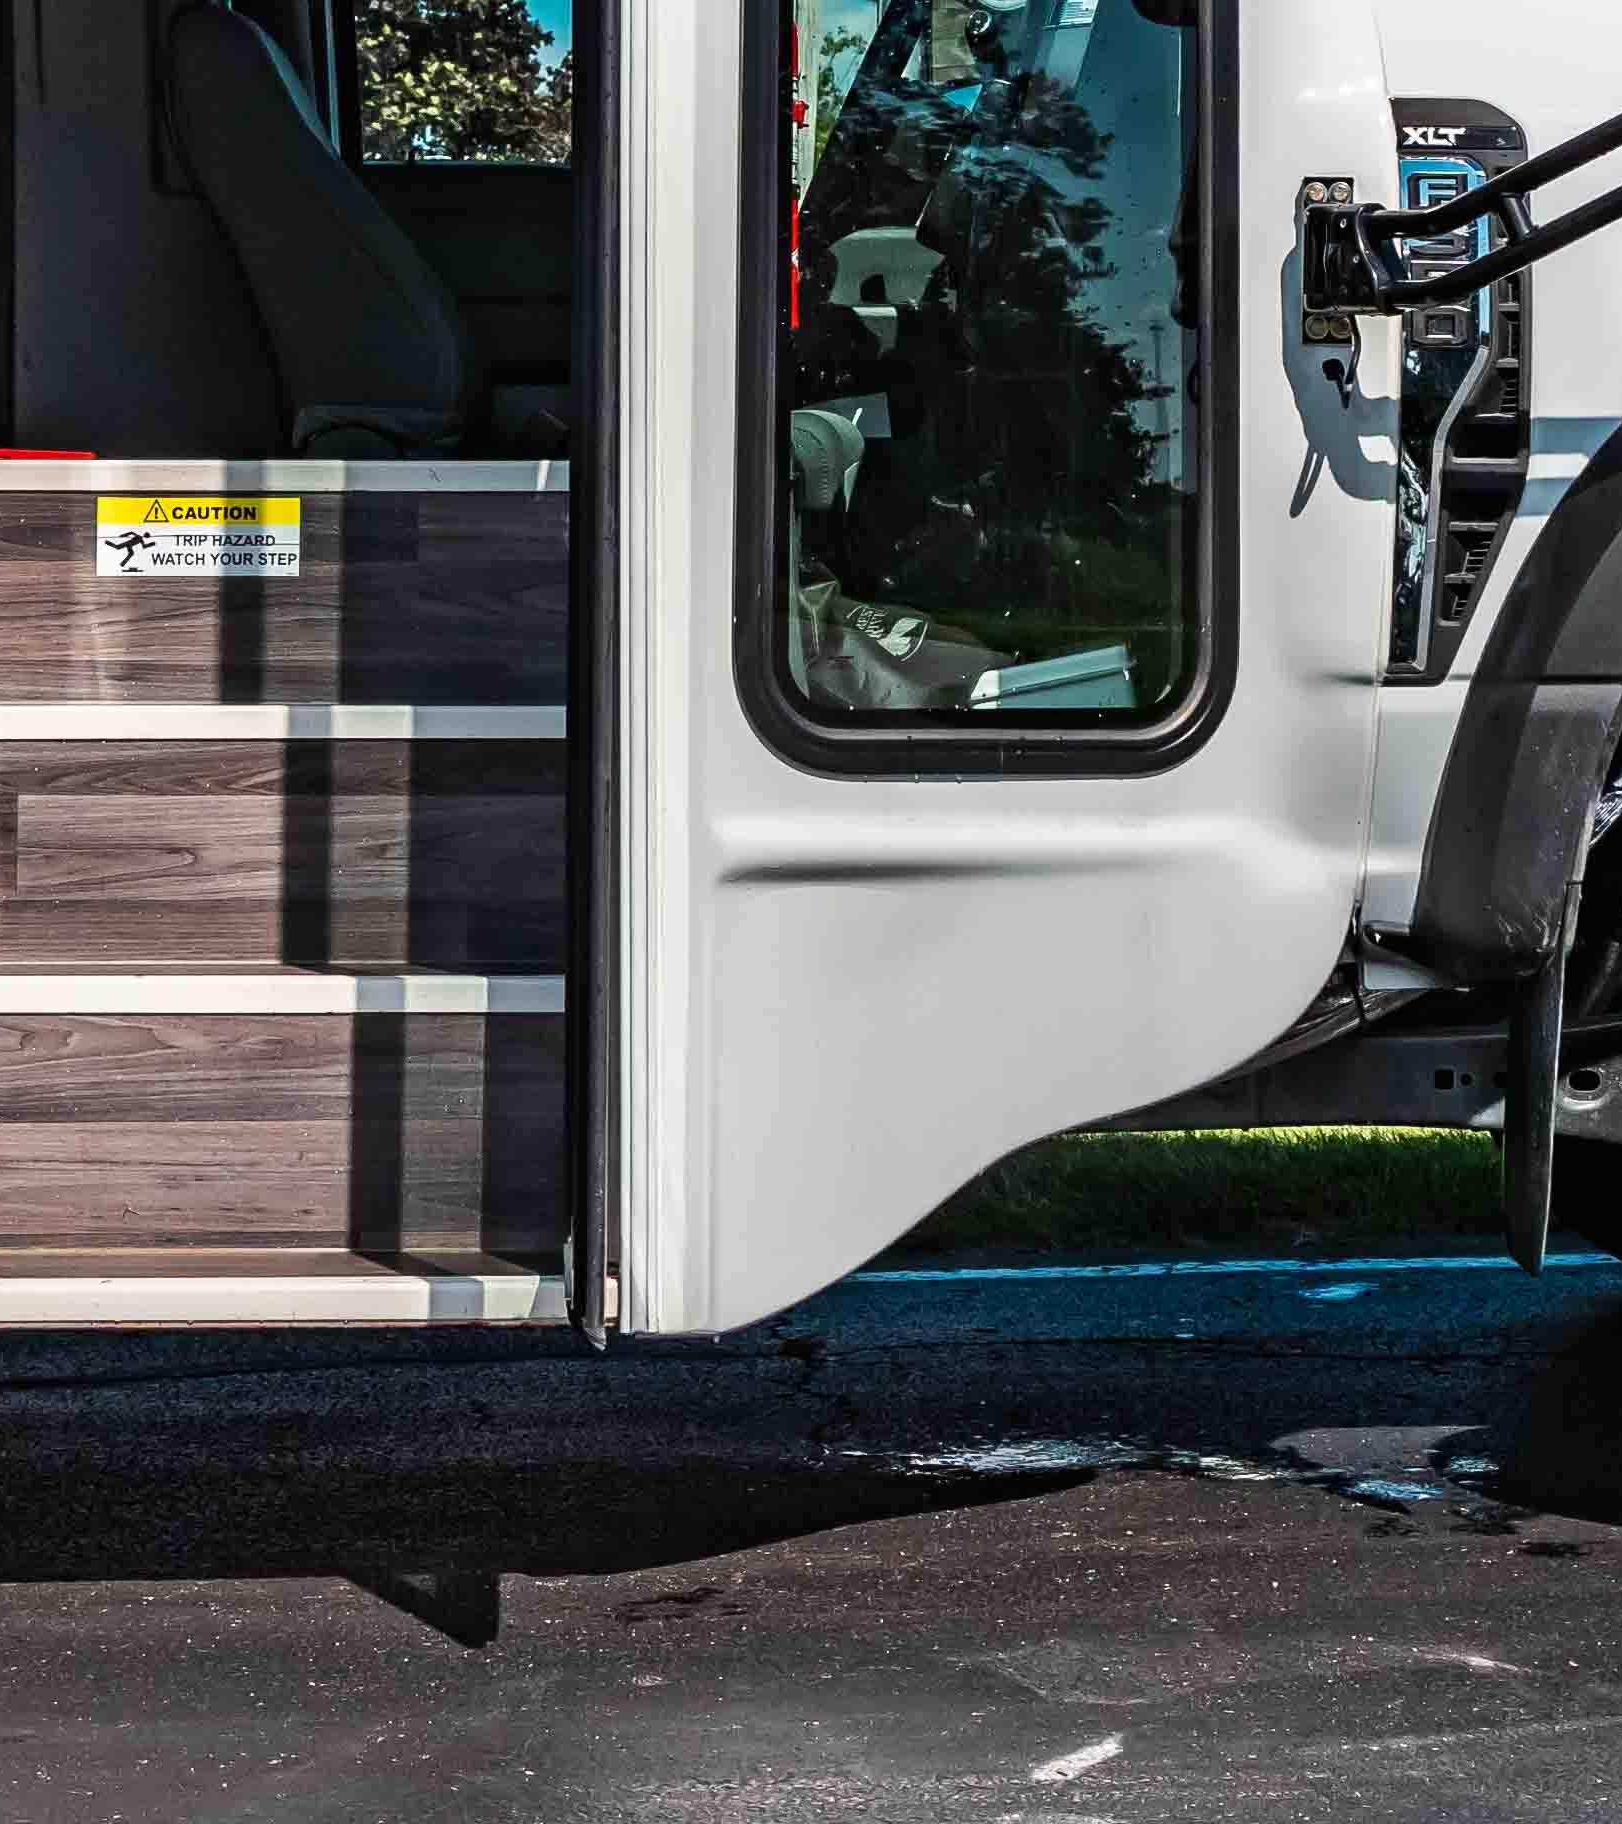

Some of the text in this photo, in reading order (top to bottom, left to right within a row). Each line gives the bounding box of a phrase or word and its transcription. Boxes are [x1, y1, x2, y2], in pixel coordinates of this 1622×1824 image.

[1401, 126, 1467, 146] XLT
[171, 505, 257, 521] CAUTION
[174, 534, 276, 547] TRIP HAZARD
[151, 552, 297, 566] WATCH YOUR STEP
